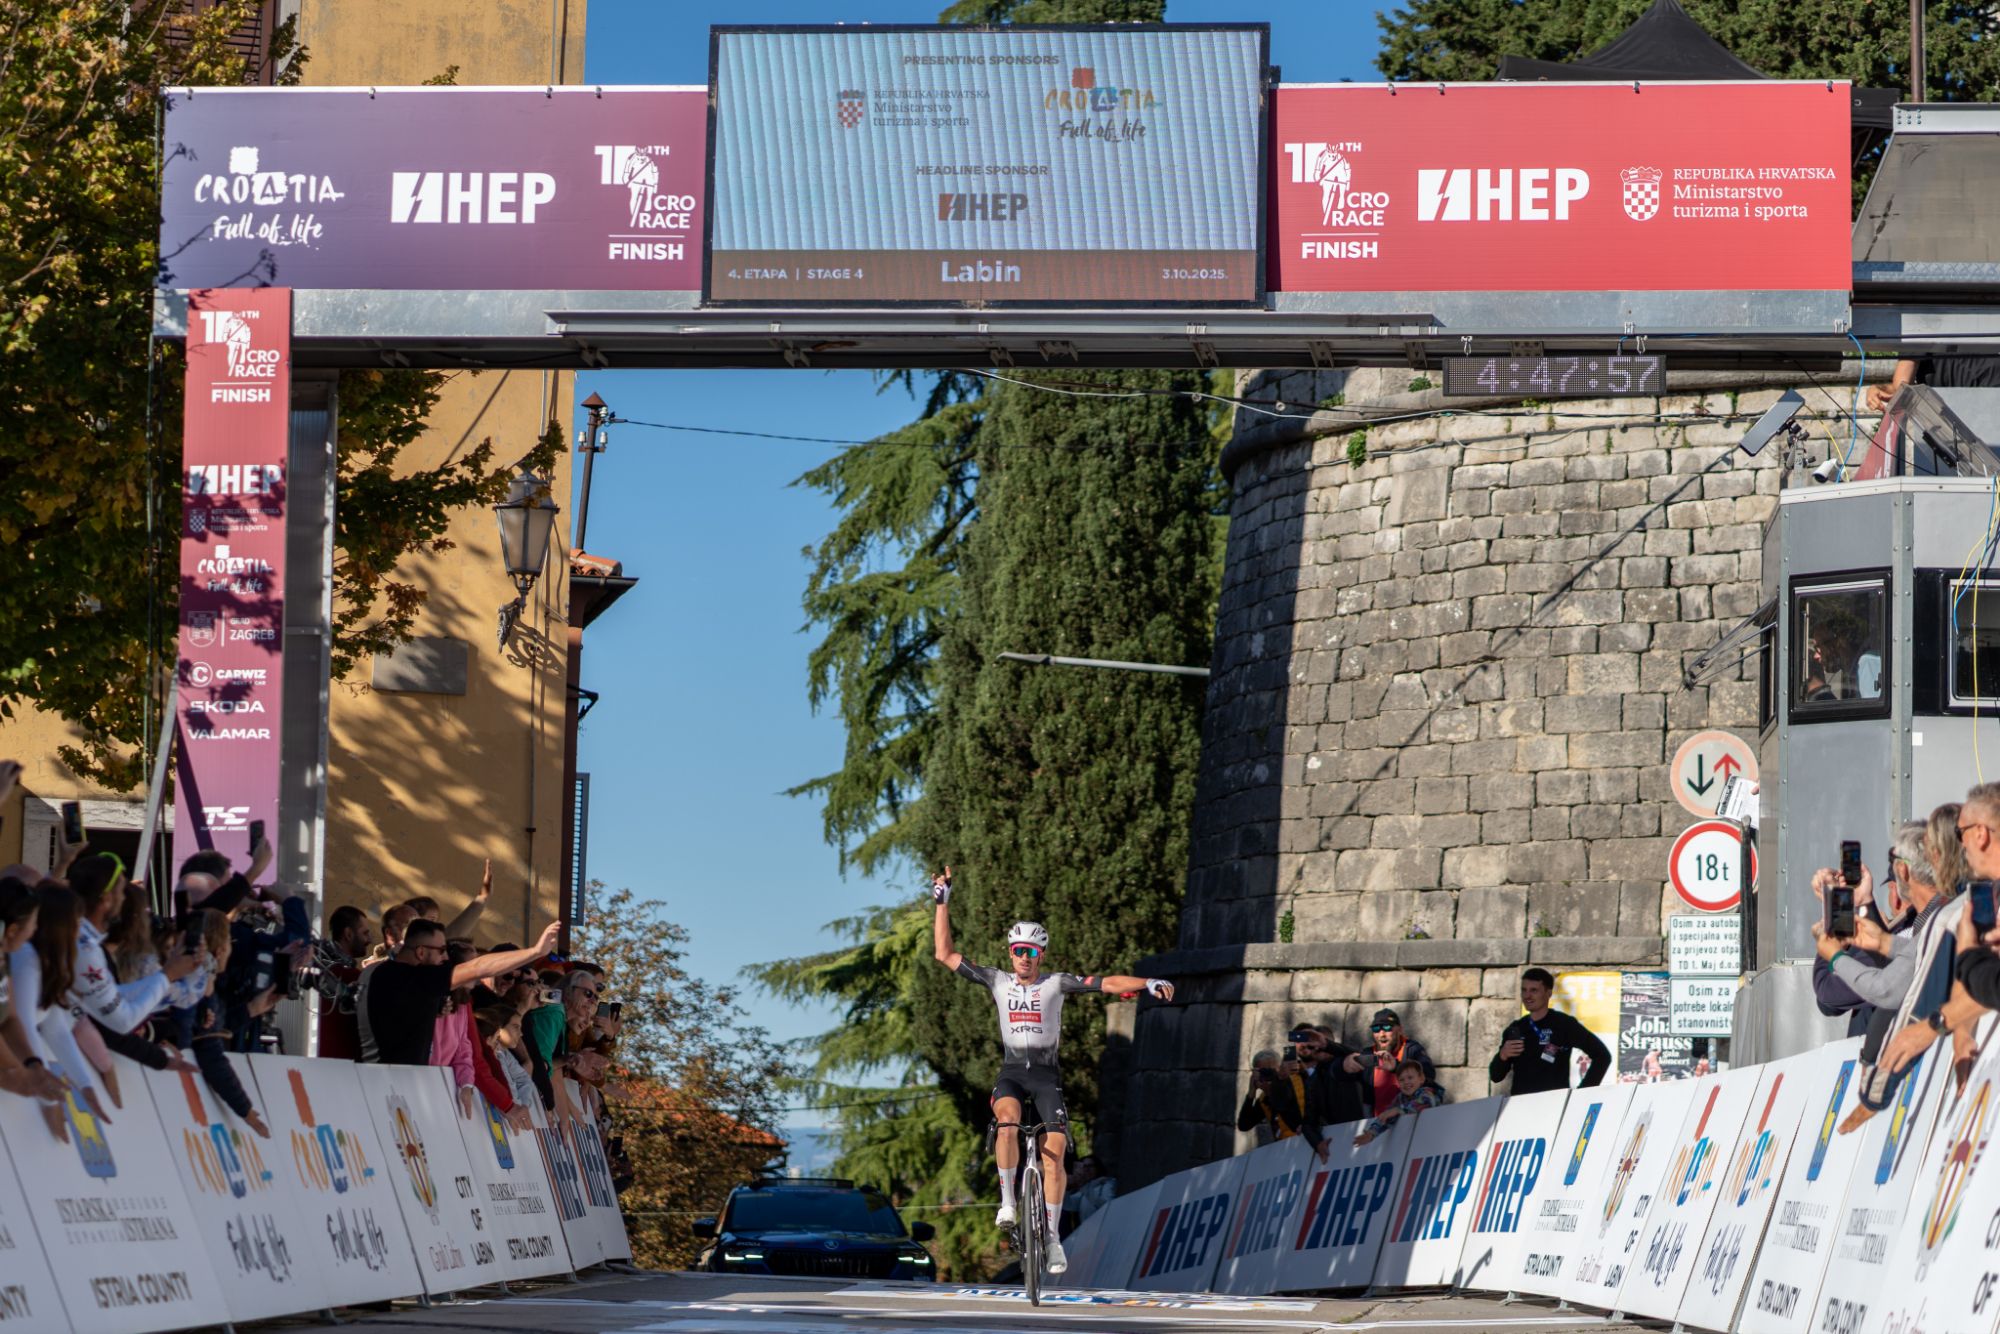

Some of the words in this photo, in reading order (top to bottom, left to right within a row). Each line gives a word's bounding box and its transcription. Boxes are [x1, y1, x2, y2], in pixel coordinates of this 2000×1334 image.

[904, 56, 986, 65] PRESENTING
[989, 55, 1060, 65] SPONSORS
[874, 90, 932, 99] REPUBLIKA
[935, 90, 990, 99] HRVATSKA
[1045, 87, 1164, 112] CROATIA
[874, 102, 952, 113] Ministarstvo
[873, 116, 921, 127] turizma
[923, 117, 928, 126] i
[931, 117, 970, 129] sporta
[916, 165, 980, 175] HEADLINE
[985, 165, 1048, 175] SPONSOR
[1673, 168, 1755, 180] REPUBLIKA
[1758, 167, 1836, 179] HRVATSKA
[194, 172, 346, 205] CROATIA
[1477, 168, 1590, 221] HEP
[1673, 184, 1783, 199] Ministarstvo
[447, 171, 556, 224] HEP
[653, 195, 696, 211] CRO
[1346, 192, 1390, 208] CRO
[969, 193, 1028, 220] HEP
[1673, 202, 1740, 218] turizma
[1744, 202, 1751, 218] i
[1754, 204, 1808, 221] sporta
[639, 213, 691, 228] RACE
[1332, 210, 1385, 227] RACE
[212, 212, 255, 241] Full
[258, 214, 284, 244] of
[291, 214, 323, 245] life
[609, 243, 684, 260] FINISH
[1302, 241, 1378, 259] FINISH
[728, 268, 741, 279] 4.
[744, 268, 788, 279] ETAPA
[807, 268, 851, 279] STAGE
[854, 268, 864, 279] 4
[942, 260, 1021, 282] Labin
[247, 350, 280, 363] CRO
[235, 363, 276, 377] RACE
[1477, 356, 1660, 393] 4:47:57
[211, 388, 271, 402] FINISH
[220, 464, 282, 495] HEP
[229, 629, 276, 641] ZAGREB
[215, 669, 267, 679] CARWIZ
[187, 728, 271, 740] VALAMAR
[1672, 918, 1693, 928] Osim
[1696, 919, 1706, 928] za
[1710, 918, 1740, 928] autobu
[1680, 931, 1720, 943] specijalna
[1723, 932, 1740, 940] voz
[1672, 946, 1681, 954] za
[1684, 946, 1718, 956] prijevoz
[1721, 945, 1740, 955] otpa
[1701, 960, 1717, 971] Maj
[1688, 985, 1713, 997] Osim
[1718, 986, 1730, 996] za
[1008, 999, 1041, 1012] UAE
[1673, 1001, 1706, 1014] potrebe
[1011, 1025, 1043, 1034] XRG
[1621, 1030, 1693, 1051] Strauss
[1487, 1138, 1546, 1233] HEP
[1413, 1149, 1478, 1241] HEP
[1246, 1170, 1302, 1255] HEP
[1322, 1162, 1394, 1248] HEP
[1163, 1193, 1230, 1274] HEP
[89, 1275, 142, 1309] ISTRIA
[137, 1271, 193, 1305] COUNTY
[1972, 1271, 1999, 1315] OF
